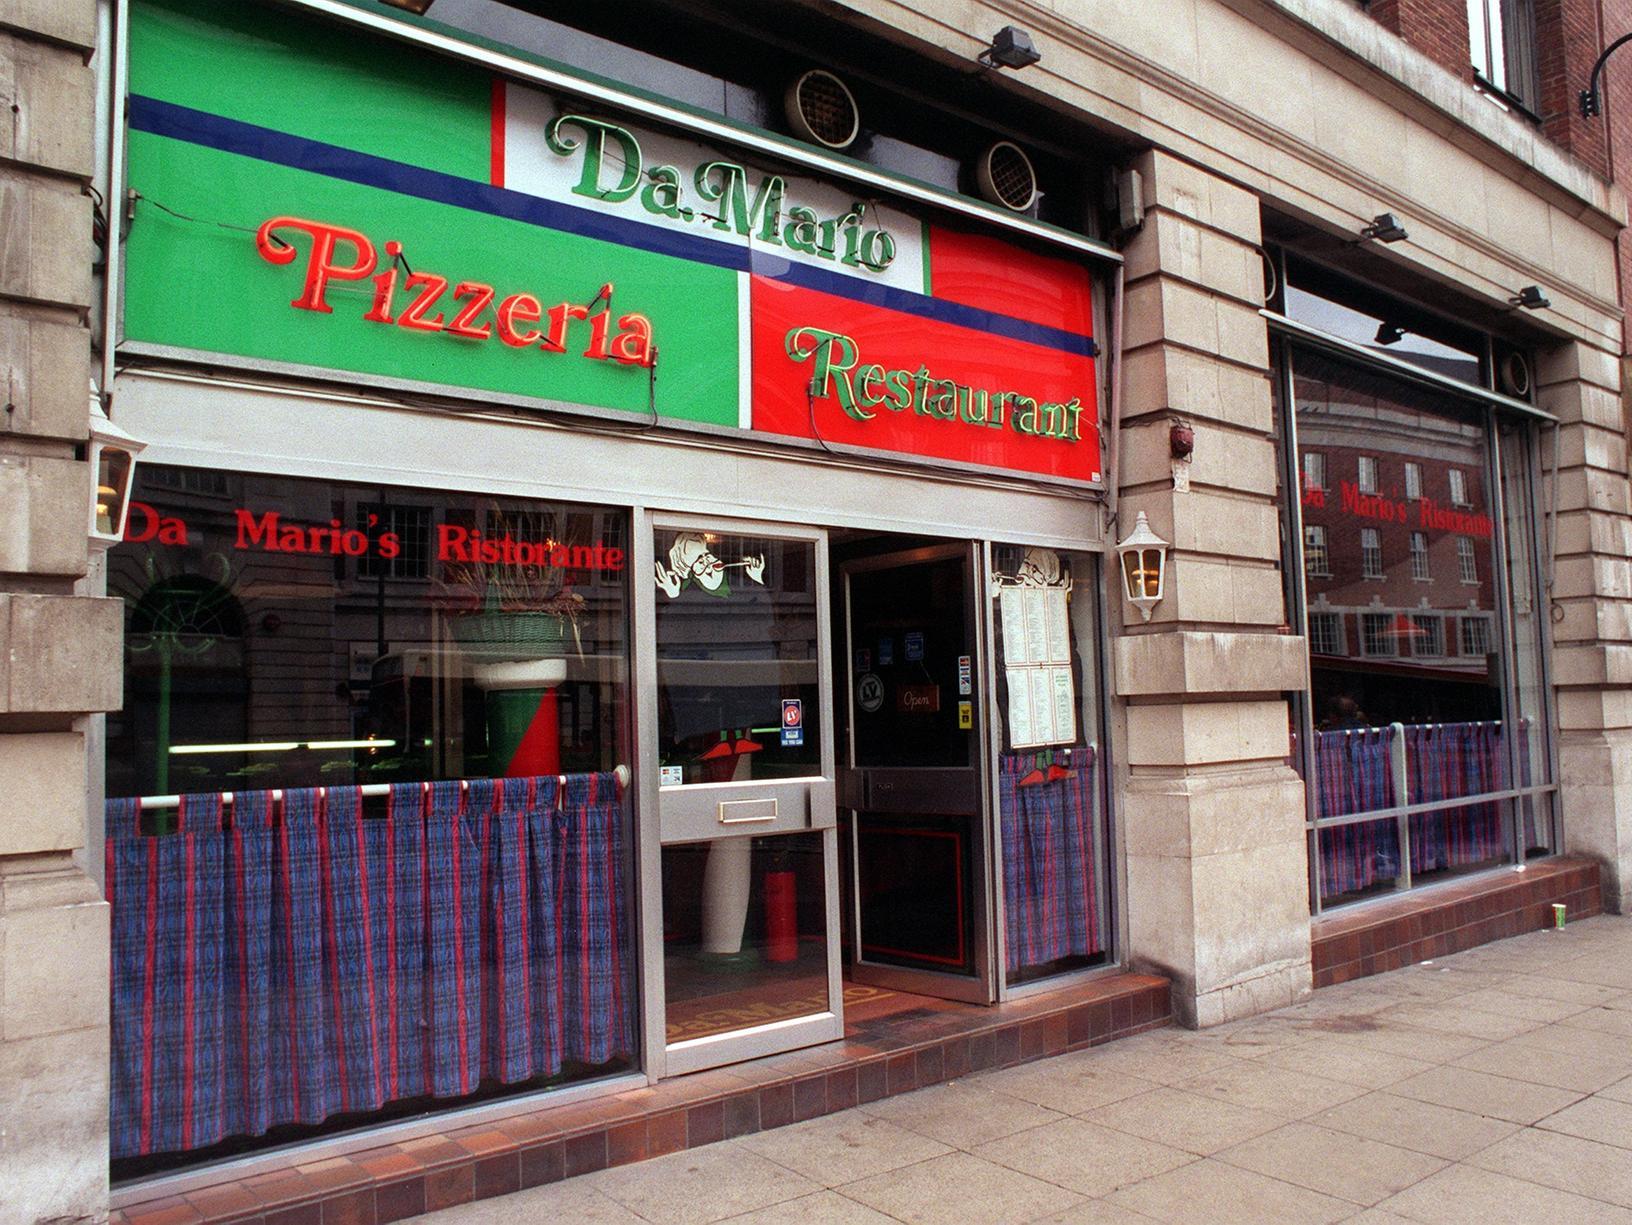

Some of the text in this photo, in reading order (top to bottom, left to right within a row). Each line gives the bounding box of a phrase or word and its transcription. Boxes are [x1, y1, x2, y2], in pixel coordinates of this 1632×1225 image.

[694, 162, 896, 272] Mario
[256, 217, 656, 367] Pizzeria
[785, 327, 1081, 442] Restaurant
[122, 502, 625, 570] Da Mario's Ristorante
[904, 690, 930, 710] Open
